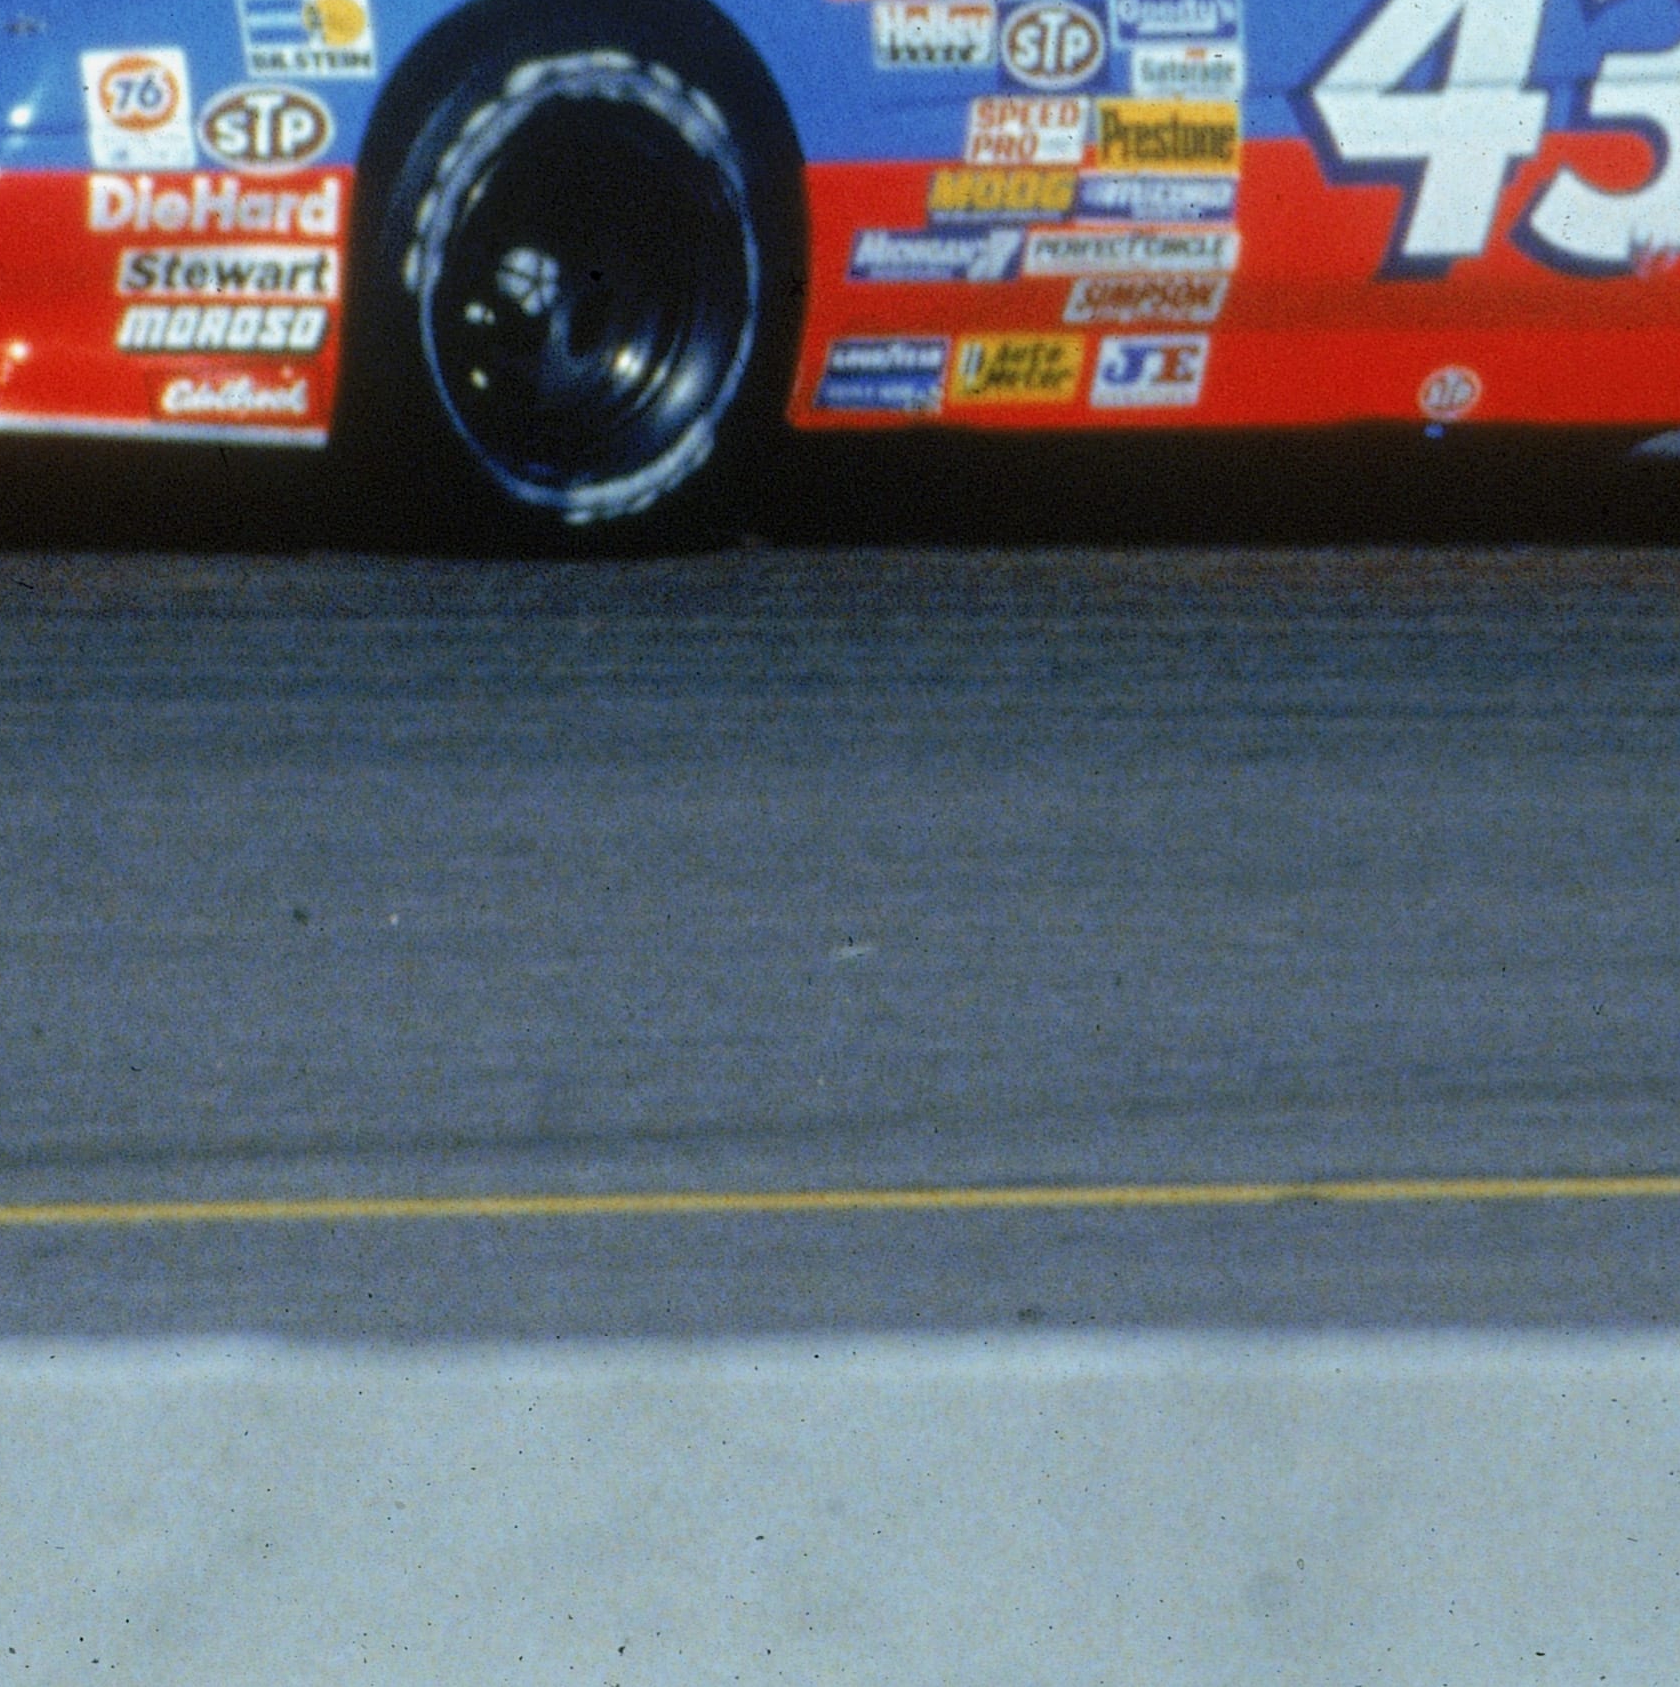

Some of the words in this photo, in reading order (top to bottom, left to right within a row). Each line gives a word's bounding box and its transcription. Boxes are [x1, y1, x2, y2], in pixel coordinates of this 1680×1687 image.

[1014, 11, 1092, 74] STP
[113, 74, 163, 113] 76
[976, 100, 1080, 128] SPEED
[213, 94, 316, 159] STP
[1100, 108, 1238, 163] Prestone
[971, 135, 1038, 161] PRO
[88, 174, 341, 236] DieHard
[929, 169, 1078, 211] MOOG
[125, 252, 331, 291] Stewart
